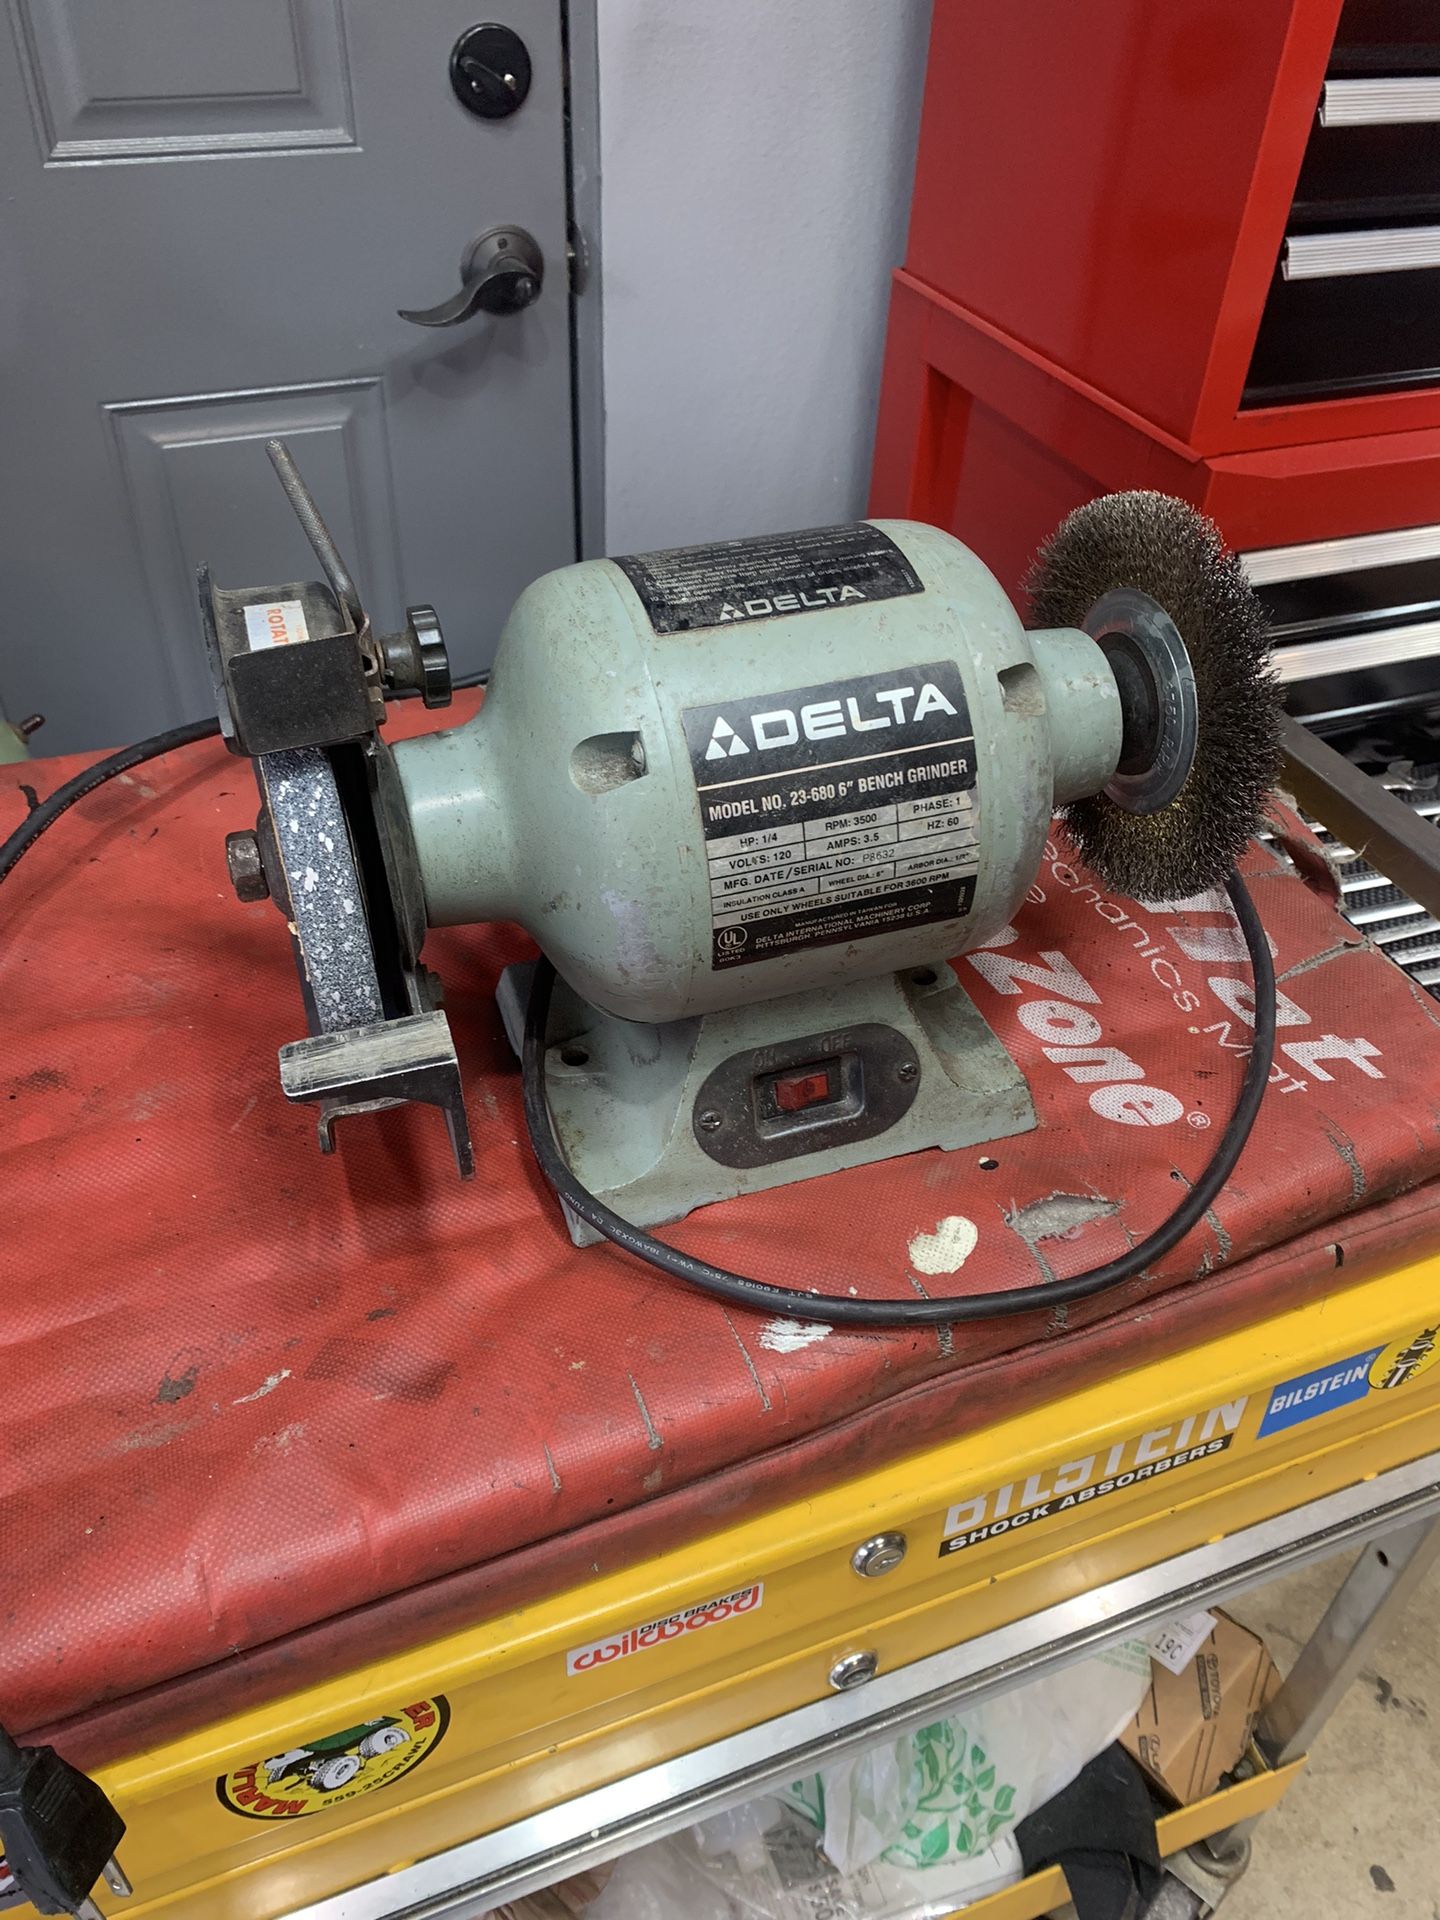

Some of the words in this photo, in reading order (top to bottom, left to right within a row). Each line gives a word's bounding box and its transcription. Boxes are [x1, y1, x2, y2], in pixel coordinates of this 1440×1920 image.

[745, 585, 866, 616] DELTA
[751, 683, 958, 751] DELTA
[709, 799, 760, 822] MODEL
[761, 794, 787, 812] NO.
[789, 784, 836, 806] 23-680
[858, 771, 904, 793] BENCH
[907, 759, 968, 783] GRINDER
[913, 799, 953, 813] PHASE:
[955, 797, 961, 806] 1
[825, 819, 851, 832] RPM:
[853, 813, 877, 826] 3500
[927, 821, 945, 831] HZ:
[947, 816, 960, 827] 60
[740, 837, 759, 849] HP:
[762, 833, 778, 844] 1/4
[827, 836, 861, 851] AMPS:
[863, 832, 880, 844] 3.5
[773, 850, 792, 862] 120
[862, 848, 895, 863] P8632
[907, 860, 934, 872] ARBOR
[723, 877, 752, 891] MFG.
[835, 857, 855, 868] NO:
[828, 877, 855, 888] WHEEL
[723, 893, 771, 908] INSULATION
[772, 887, 798, 899] CLASS
[741, 911, 760, 922] USE
[762, 905, 789, 917] ONLY
[792, 897, 832, 911] WHEELS
[834, 886, 882, 903] SUITABLE
[884, 881, 904, 893] FOR
[905, 876, 927, 889] 3600
[929, 872, 950, 883] RPM
[724, 930, 742, 946] UL
[755, 932, 784, 945] DELTA
[786, 916, 855, 937] INTERNATIONAL
[856, 906, 906, 922] MACHINERY
[814, 919, 880, 938] PENNSYLVANIA
[1043, 839, 1200, 1013] echanics
[1269, 1363, 1369, 1415] BILSTEIN
[949, 1504, 1051, 1551] SHOCK
[1059, 1438, 1225, 1511] ABSORBERS
[640, 1613, 681, 1635] DISC
[684, 1587, 753, 1618] BRAKES
[573, 1585, 760, 1670] wilwood
[1154, 1633, 1183, 1661] 19C
[232, 1762, 309, 1815] MARLI
